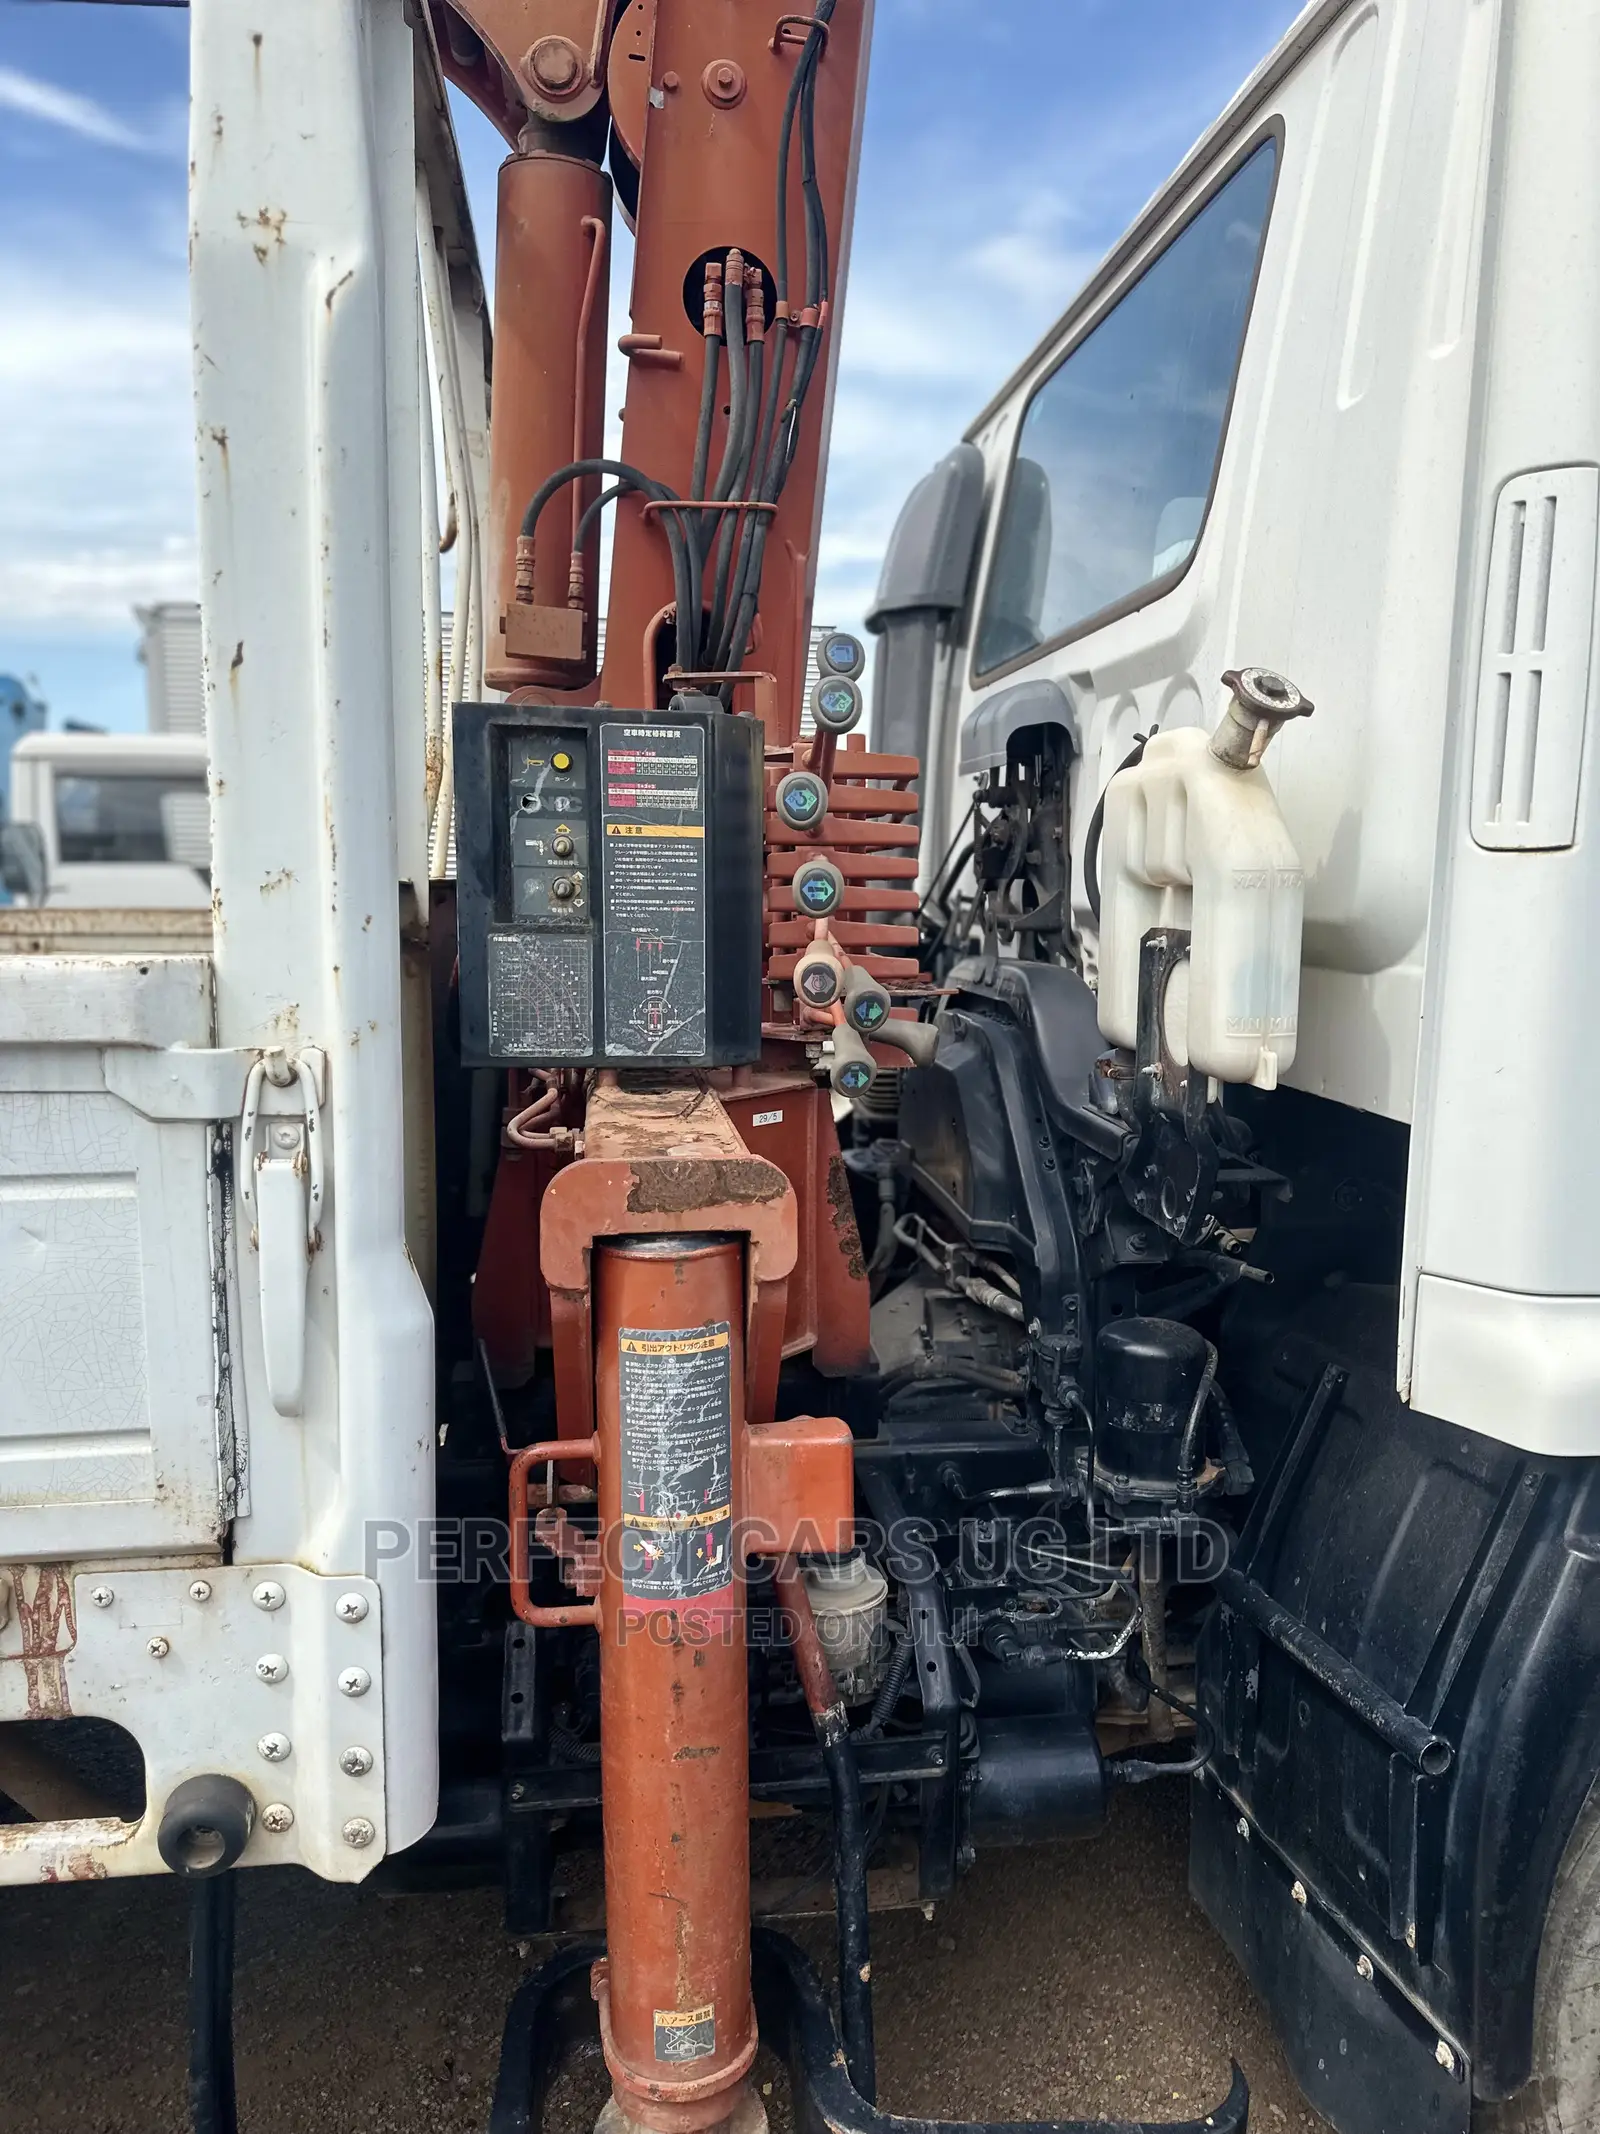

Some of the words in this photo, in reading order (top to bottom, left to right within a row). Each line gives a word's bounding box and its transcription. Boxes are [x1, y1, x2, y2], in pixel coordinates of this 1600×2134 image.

[625, 827, 643, 835] 注意
[1233, 874, 1266, 888] MAX
[1227, 1018, 1260, 1031] MIN
[759, 1113, 777, 1123] 29/5
